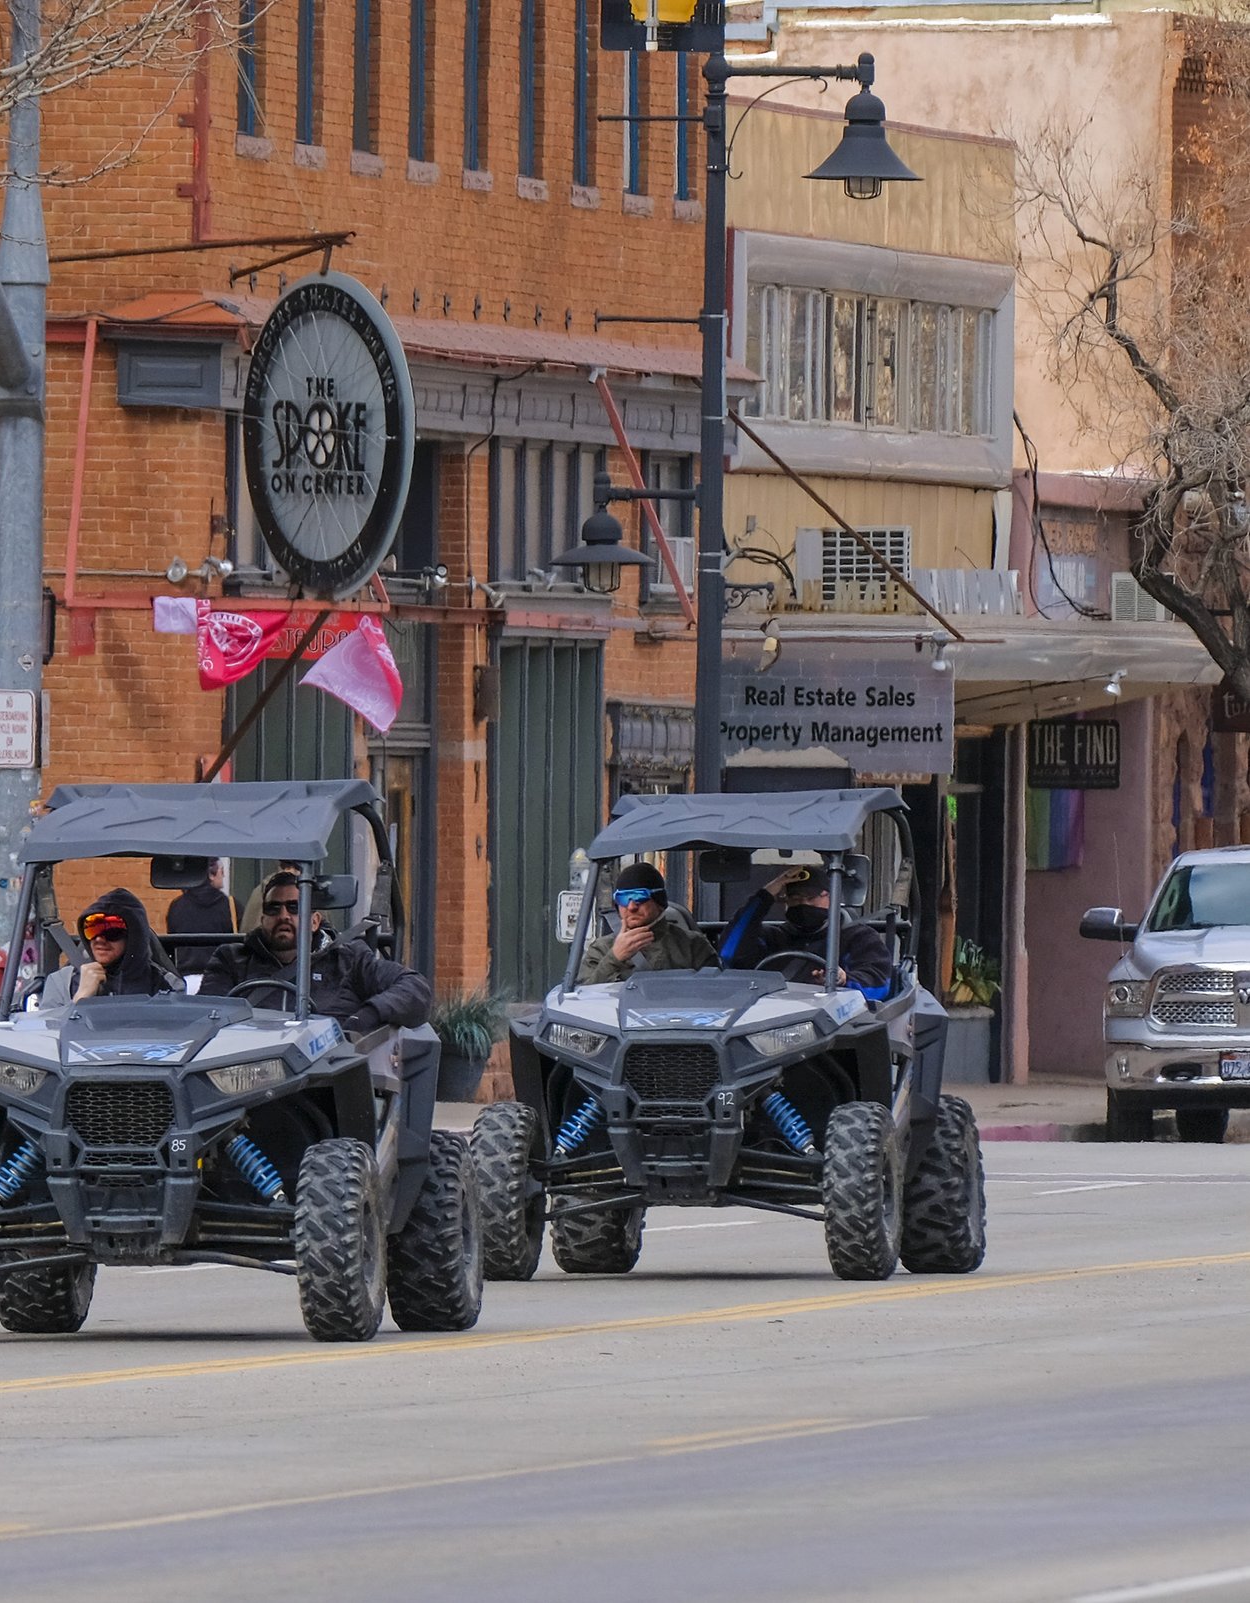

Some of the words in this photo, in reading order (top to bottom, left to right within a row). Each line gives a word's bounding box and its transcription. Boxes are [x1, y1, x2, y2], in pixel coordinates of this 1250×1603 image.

[306, 376, 335, 397] THE
[271, 400, 367, 472] SPOKE
[271, 474, 295, 495] ON
[302, 474, 365, 496] CENTER
[745, 685, 785, 706] Real
[794, 686, 856, 706] Estate
[865, 685, 915, 707] Sales
[811, 721, 943, 747] Management
[1033, 724, 1067, 766] THE
[1074, 724, 1117, 766] FIND
[717, 1091, 735, 1106] 92
[171, 1139, 187, 1152] 85
